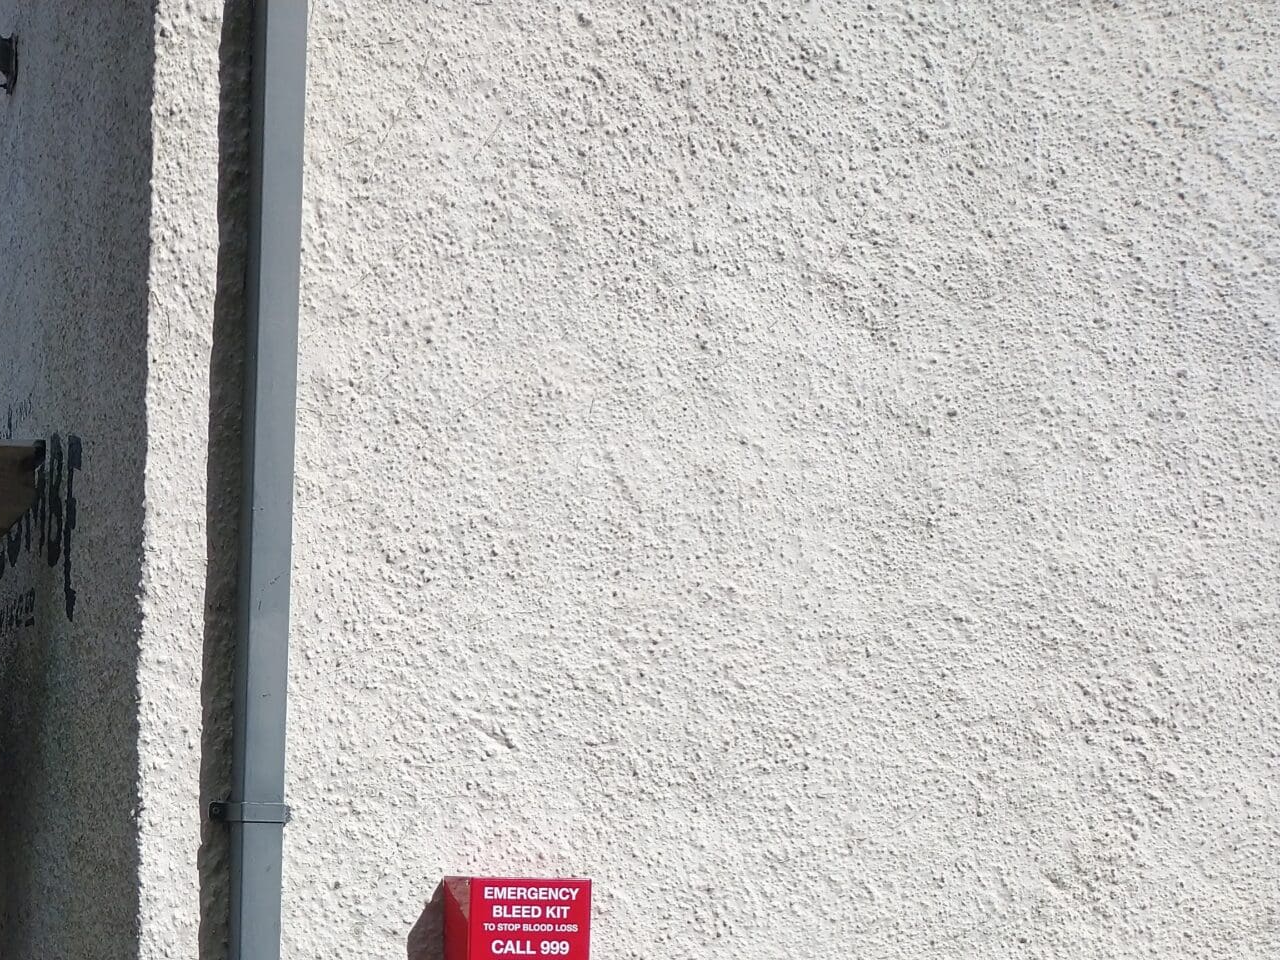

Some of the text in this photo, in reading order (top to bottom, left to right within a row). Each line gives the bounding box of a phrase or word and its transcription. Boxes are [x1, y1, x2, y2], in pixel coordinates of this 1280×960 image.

[483, 886, 580, 900] EMERGENCY
[492, 905, 571, 919] BLEED KIT
[483, 923, 579, 932] TO STOP BLOOD LOSS
[491, 939, 570, 955] CALL 999
